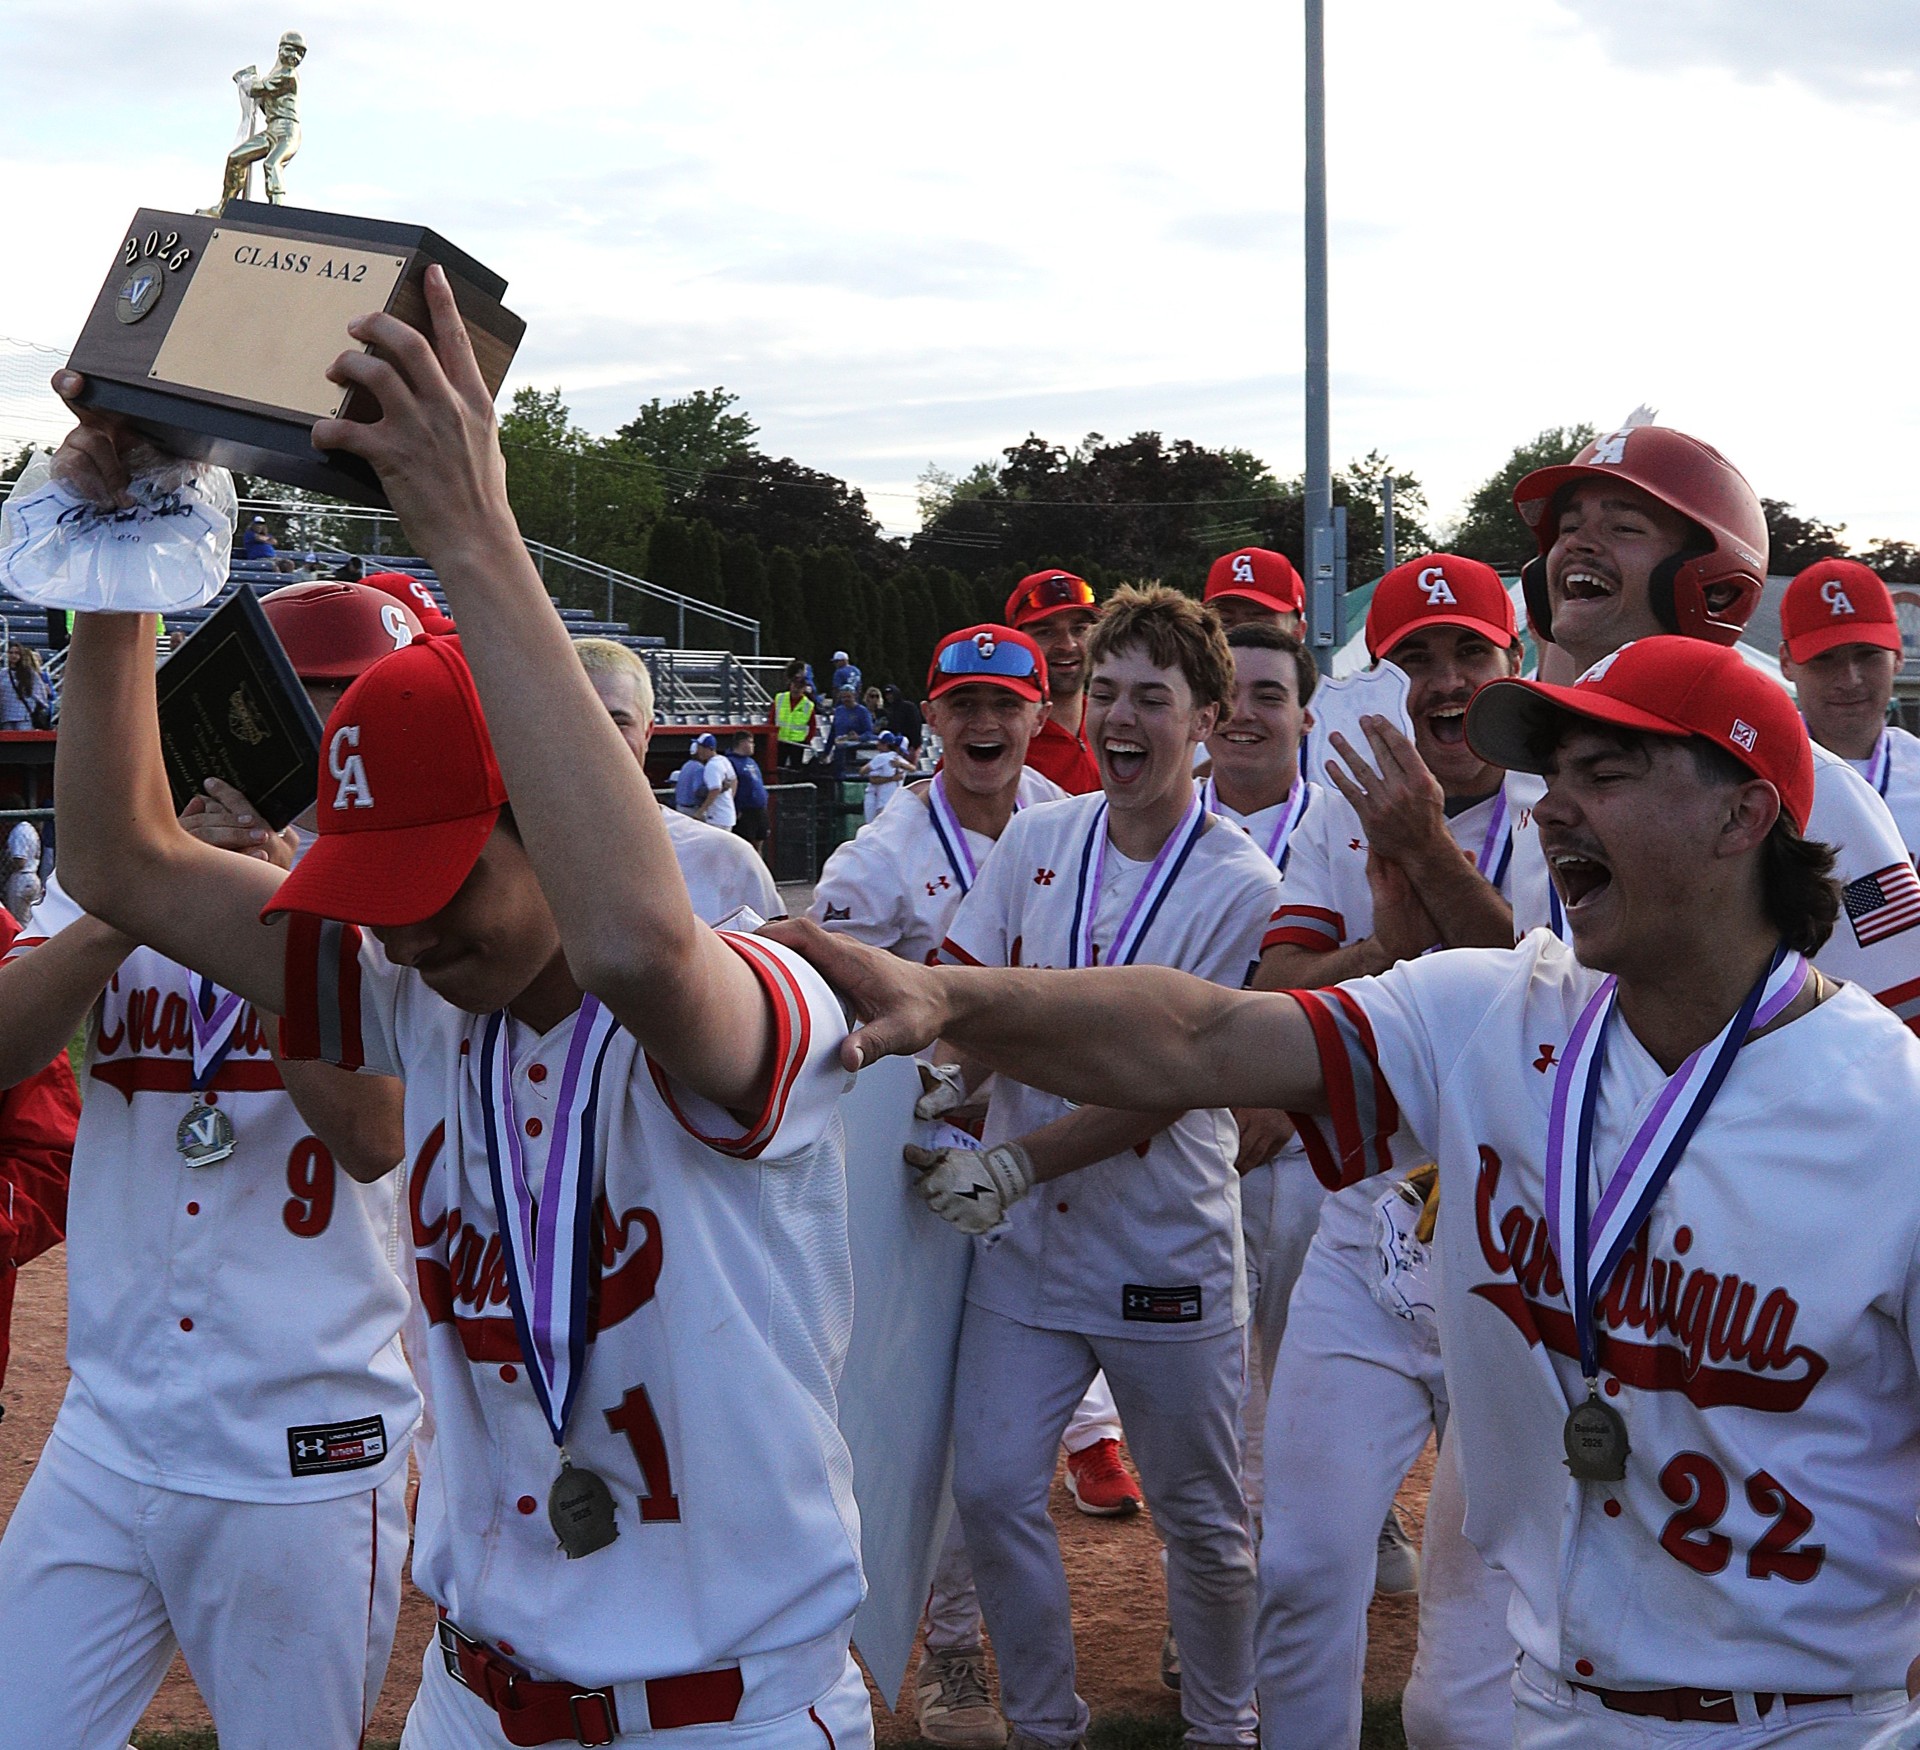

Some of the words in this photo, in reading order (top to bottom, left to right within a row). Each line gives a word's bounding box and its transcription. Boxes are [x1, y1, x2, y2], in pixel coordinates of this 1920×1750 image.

[125, 230, 190, 271] 2026
[234, 245, 311, 273] CLASS
[317, 258, 368, 283] AA2
[1231, 555, 1256, 583] CA
[1417, 567, 1457, 605] CA
[409, 582, 438, 609] CA
[1821, 580, 1856, 616] CA
[329, 725, 375, 810] CA
[282, 1134, 337, 1239] 9
[601, 1382, 682, 1525] 1
[1657, 1449, 1827, 1585] 22
